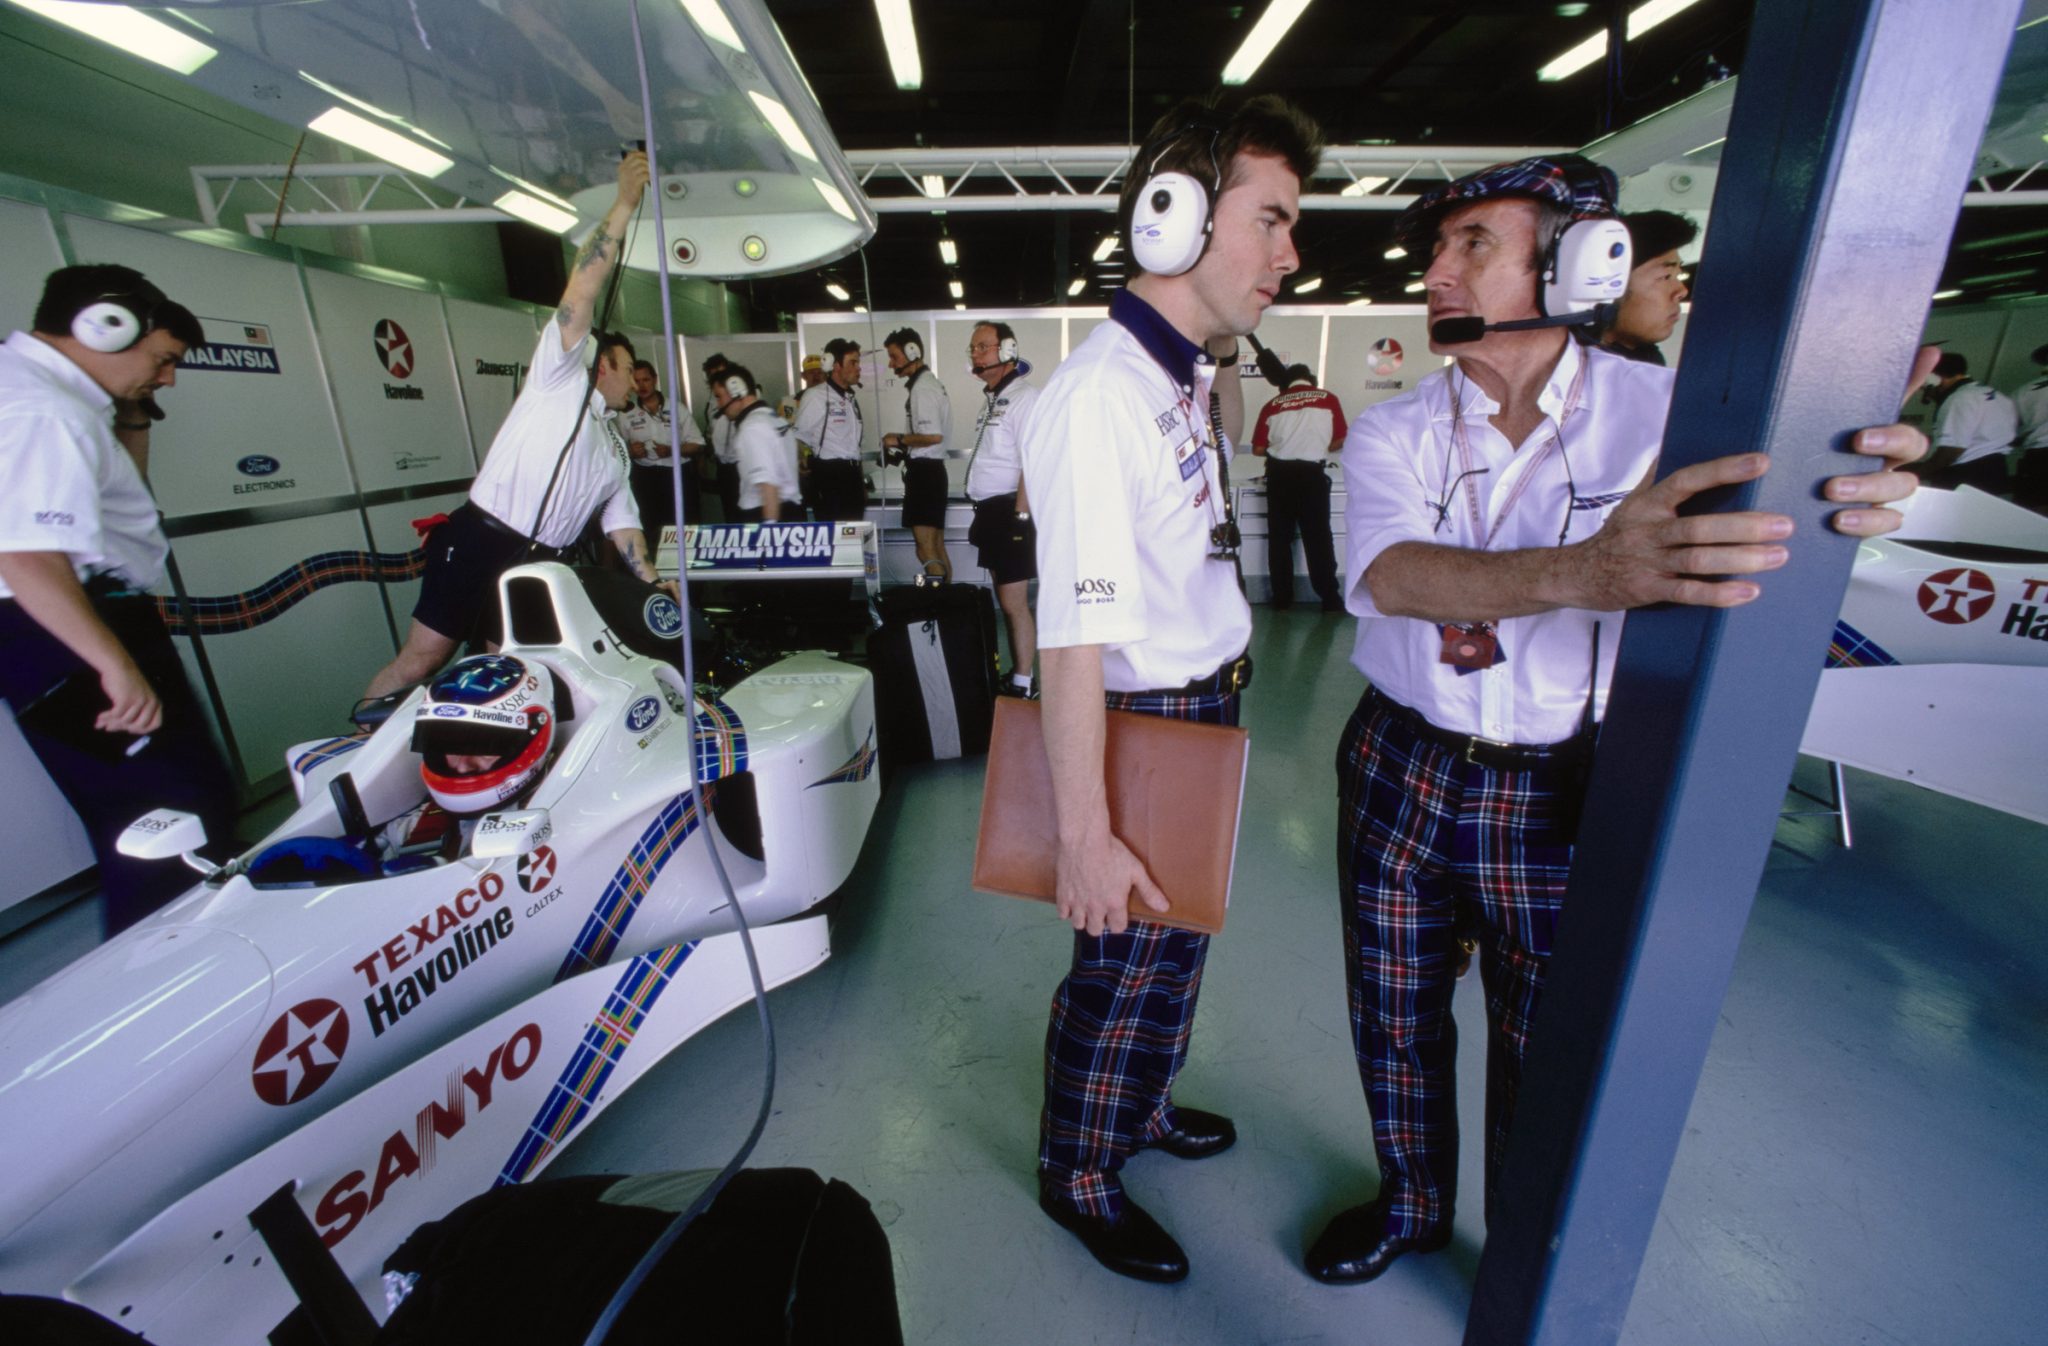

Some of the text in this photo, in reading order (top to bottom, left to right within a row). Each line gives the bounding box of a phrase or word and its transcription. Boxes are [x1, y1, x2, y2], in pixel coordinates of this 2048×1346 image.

[384, 383, 424, 400] Havoline
[1154, 407, 1180, 437] HSBC
[246, 458, 272, 473] Ford
[233, 479, 296, 494] ELECTRONICS
[699, 526, 832, 559] MALAYSIA
[653, 602, 680, 630] Ford
[473, 709, 513, 724] Havoline
[632, 701, 656, 728] Ford
[481, 821, 528, 831] BOSS
[526, 887, 563, 918] CALTEX
[353, 873, 504, 988] TEXACO
[363, 906, 514, 1038] Havoline
[315, 1023, 542, 1251] SANYO
